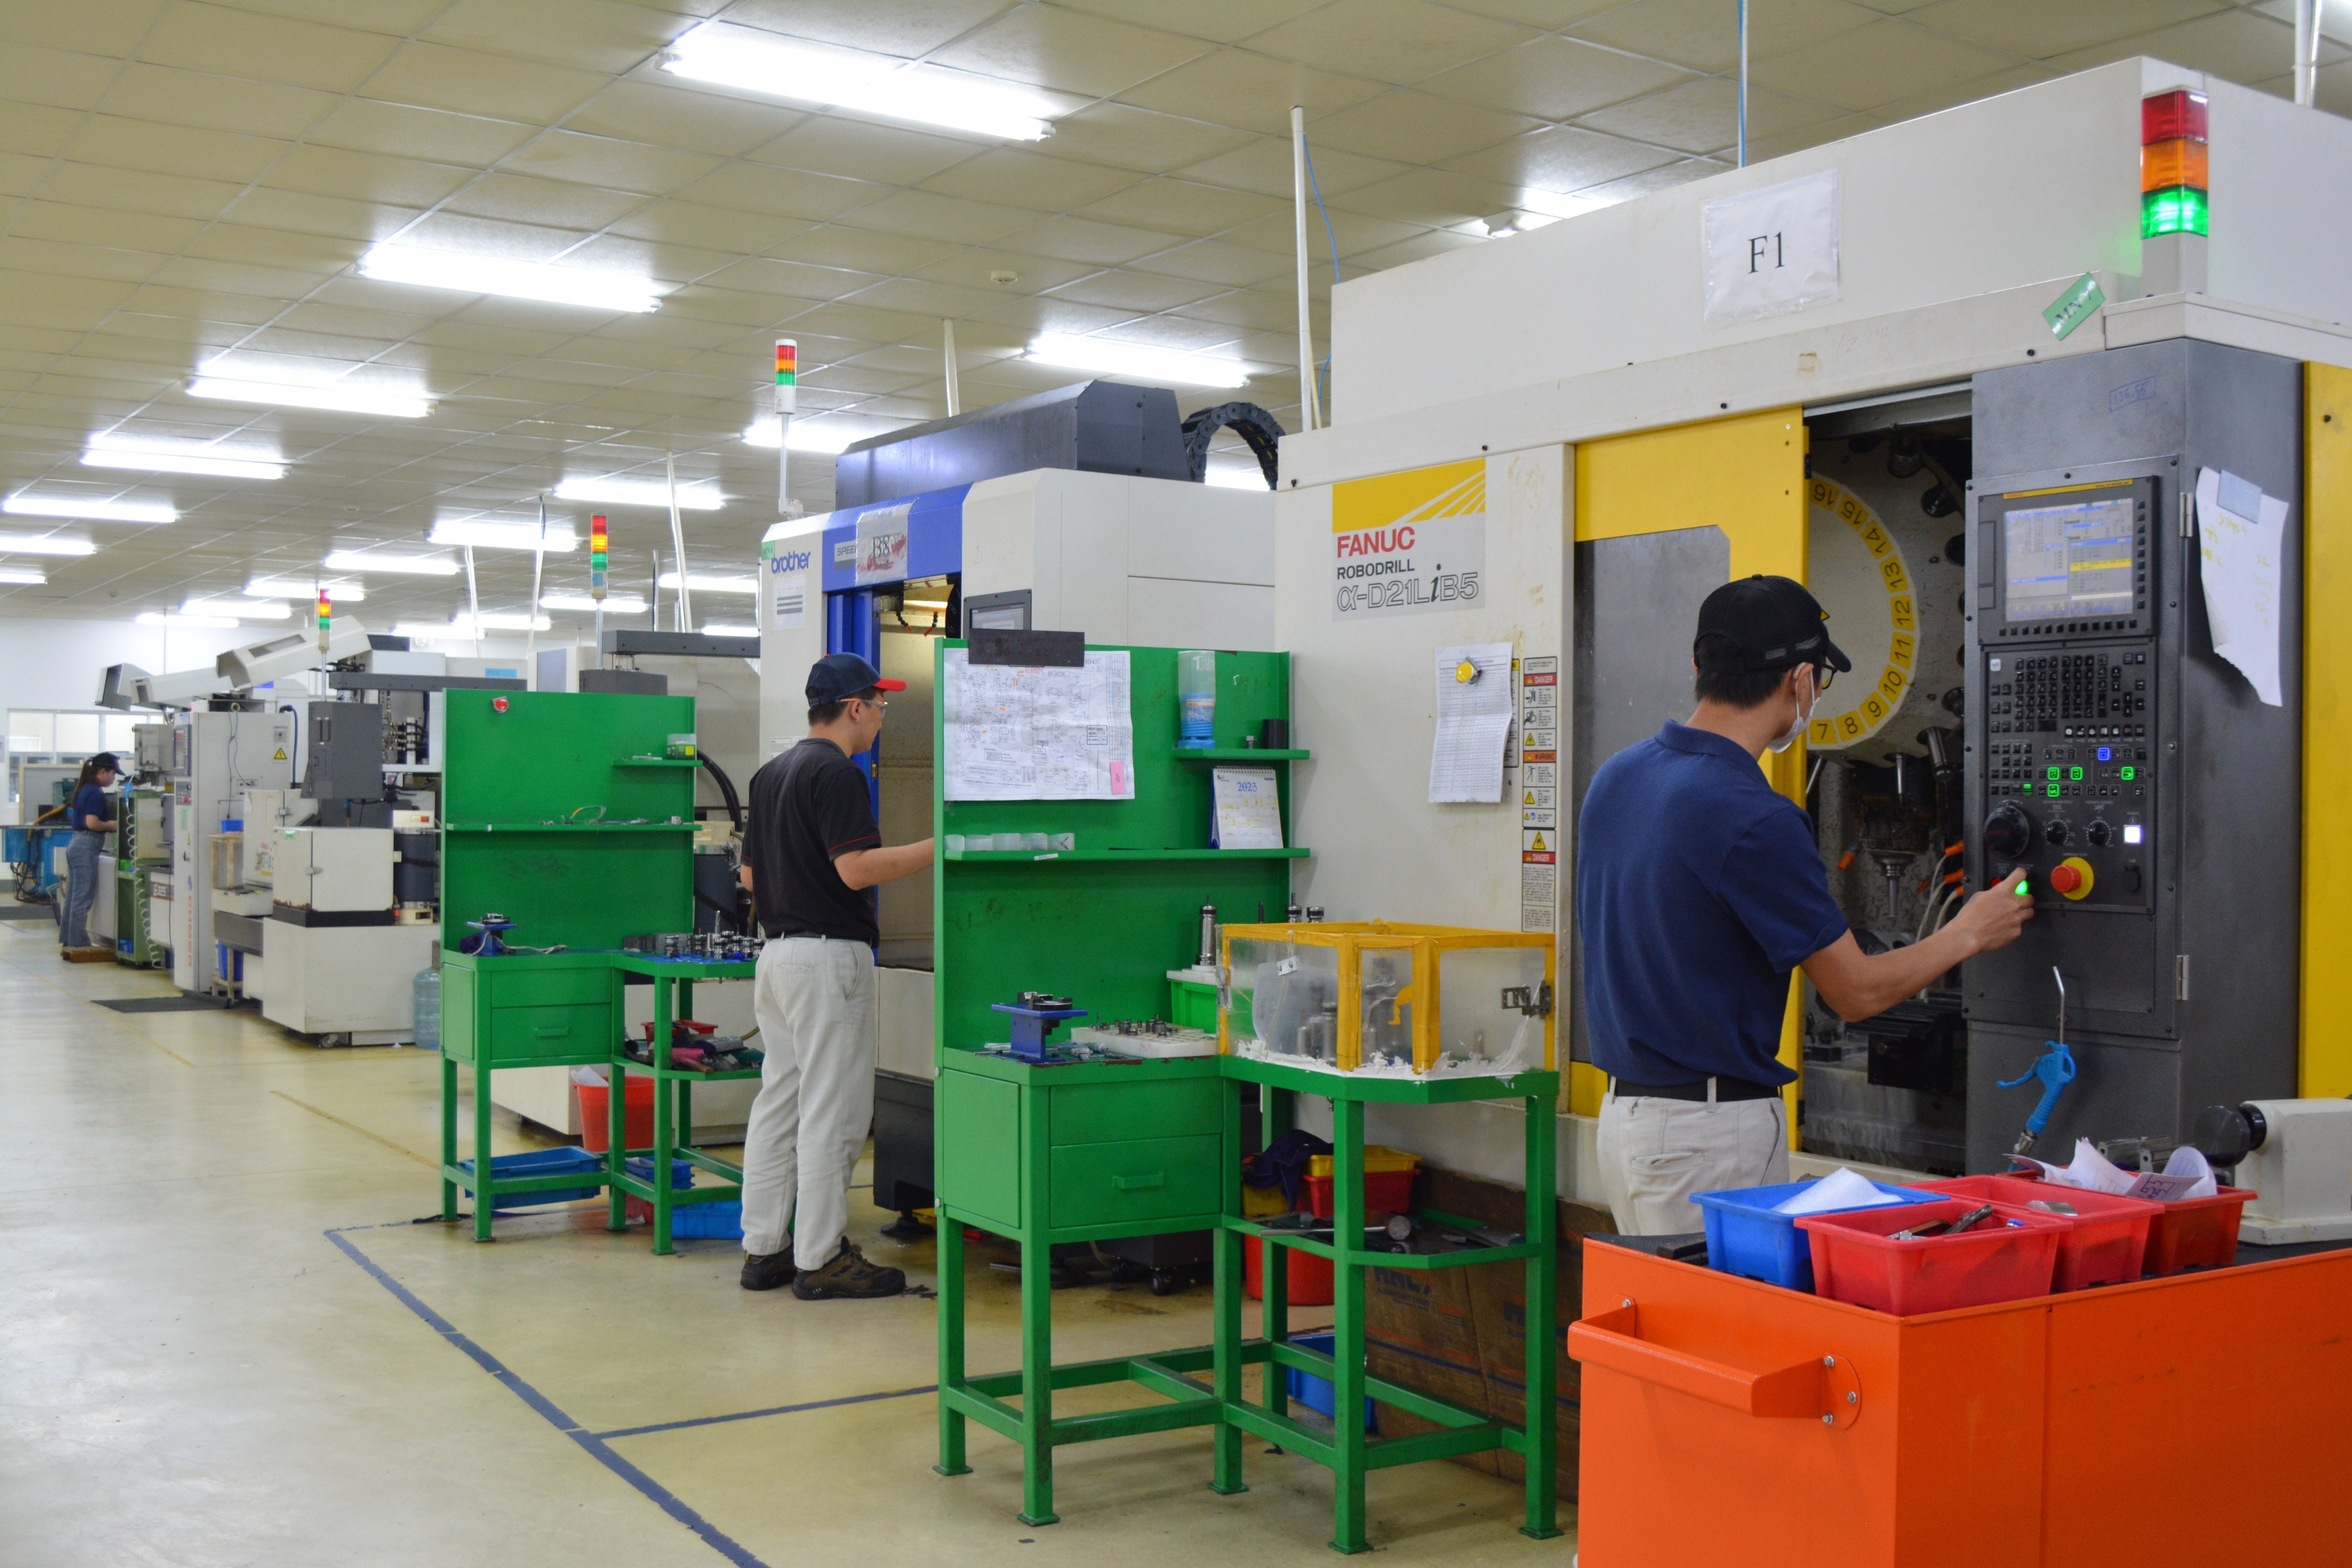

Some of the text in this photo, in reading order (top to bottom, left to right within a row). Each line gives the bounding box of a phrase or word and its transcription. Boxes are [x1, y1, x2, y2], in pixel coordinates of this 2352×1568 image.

[1748, 231, 1785, 275] F1
[1813, 484, 1835, 506] 16
[1840, 499, 1863, 525] 15
[837, 545, 856, 556] SPEE
[1337, 526, 1415, 558] FANUC
[1866, 527, 1887, 553] 14
[771, 550, 811, 574] brother
[1337, 558, 1415, 580] ROBODRILL
[1884, 561, 1904, 589] 13
[1895, 599, 1911, 625] 12
[1894, 639, 1911, 661] 11
[1534, 675, 1554, 684] DANGER
[1883, 671, 1903, 696] 10
[1817, 723, 1828, 740] 7
[1845, 716, 1859, 735] 8
[1237, 781, 1258, 792] 2023
[1532, 853, 1550, 862] DANGER
